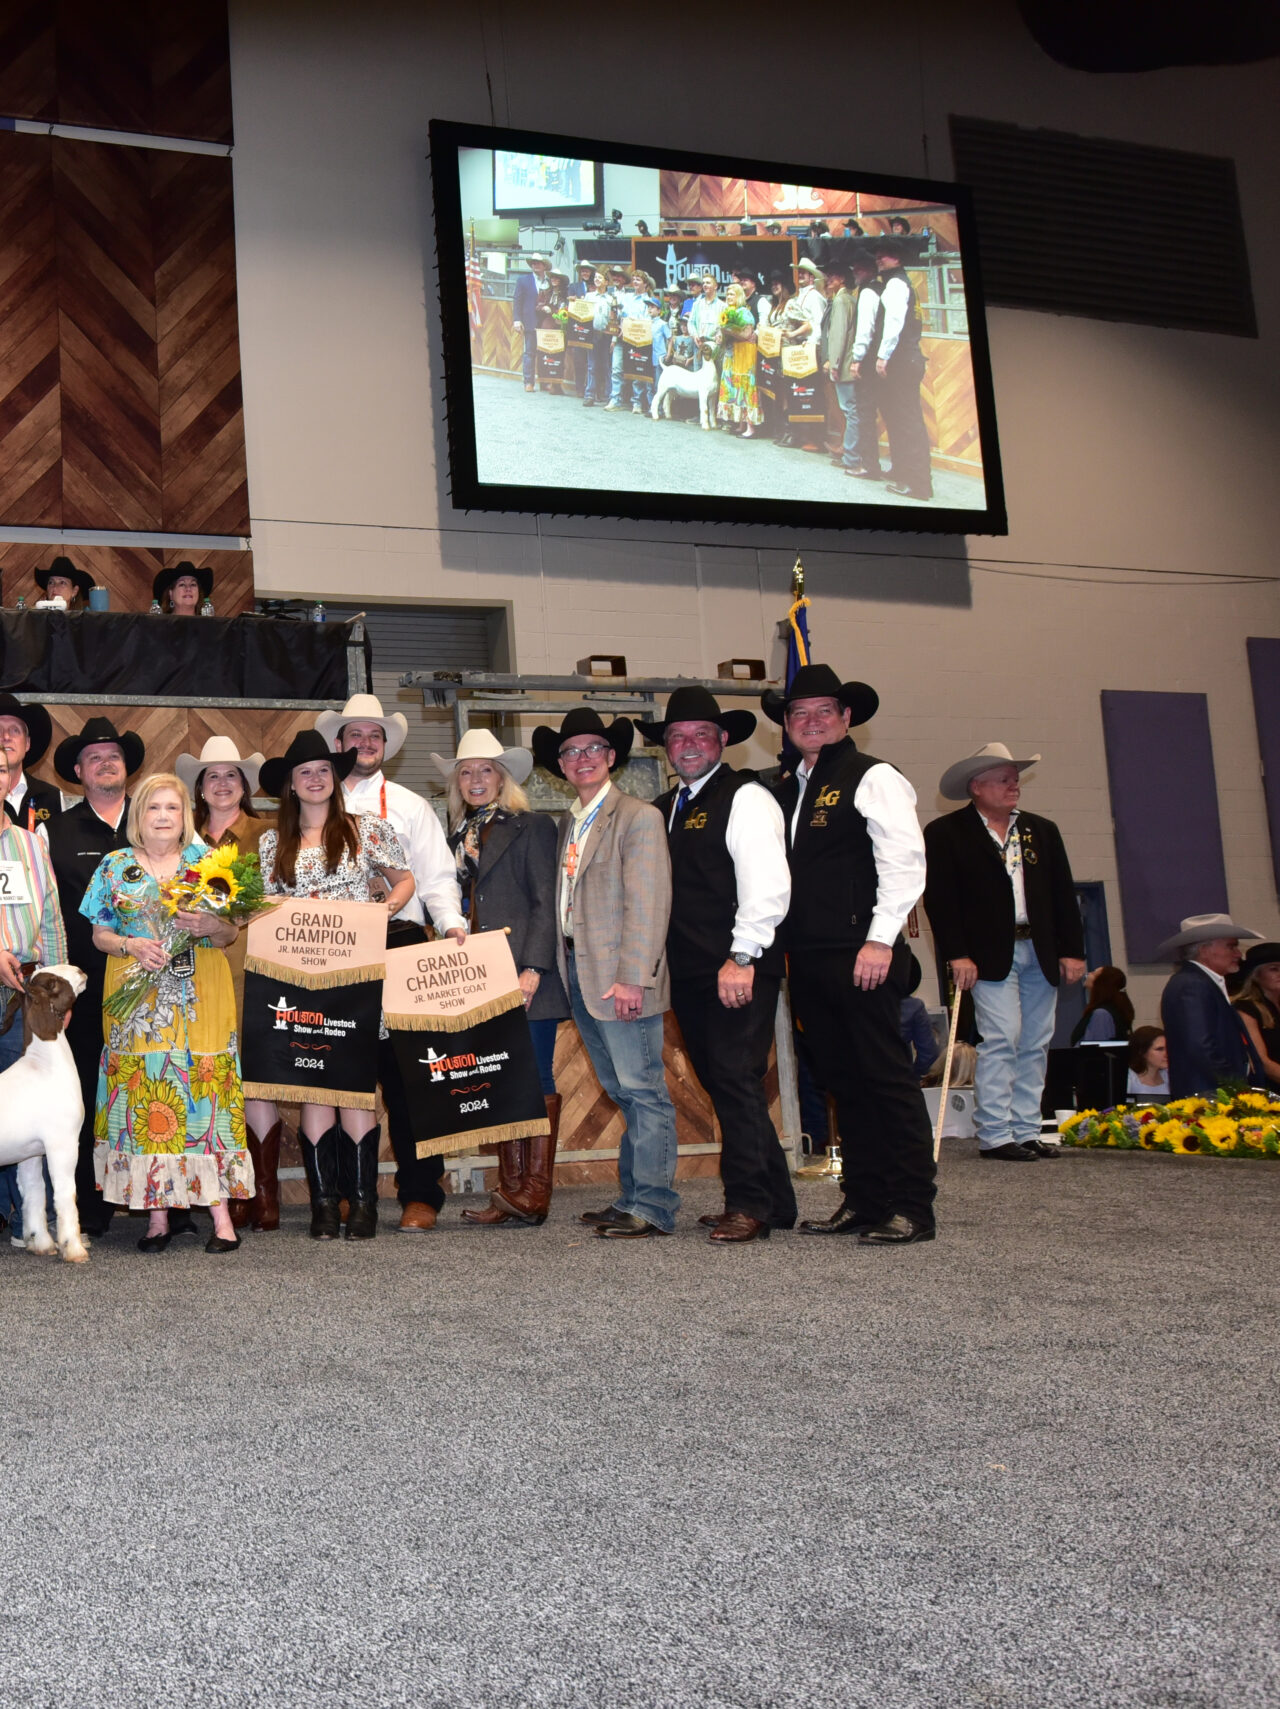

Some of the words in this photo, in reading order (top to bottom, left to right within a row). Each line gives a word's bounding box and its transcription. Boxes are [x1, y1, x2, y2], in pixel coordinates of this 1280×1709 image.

[0, 872, 12, 895] 2
[291, 912, 343, 928] GRAND
[275, 926, 357, 946] CHAMPION
[278, 945, 289, 953] JR.
[292, 946, 325, 956] MARKET
[328, 949, 352, 958] GOAT
[301, 956, 327, 966] SHOW
[416, 951, 469, 973] GRAND
[406, 964, 488, 992] CHAMPION
[414, 994, 425, 1004] JR.
[427, 987, 462, 1002] MARKET
[463, 982, 487, 995] GOAT
[440, 997, 465, 1009] SHOW
[294, 1024, 312, 1034] Show
[324, 1027, 346, 1037] Rodeo
[324, 1017, 356, 1029] Livestock
[295, 1057, 325, 1070] 2024
[476, 1052, 509, 1065] Livestock
[450, 1069, 468, 1080] Show
[479, 1063, 501, 1075] Rodeo
[459, 1098, 489, 1114] 2024
